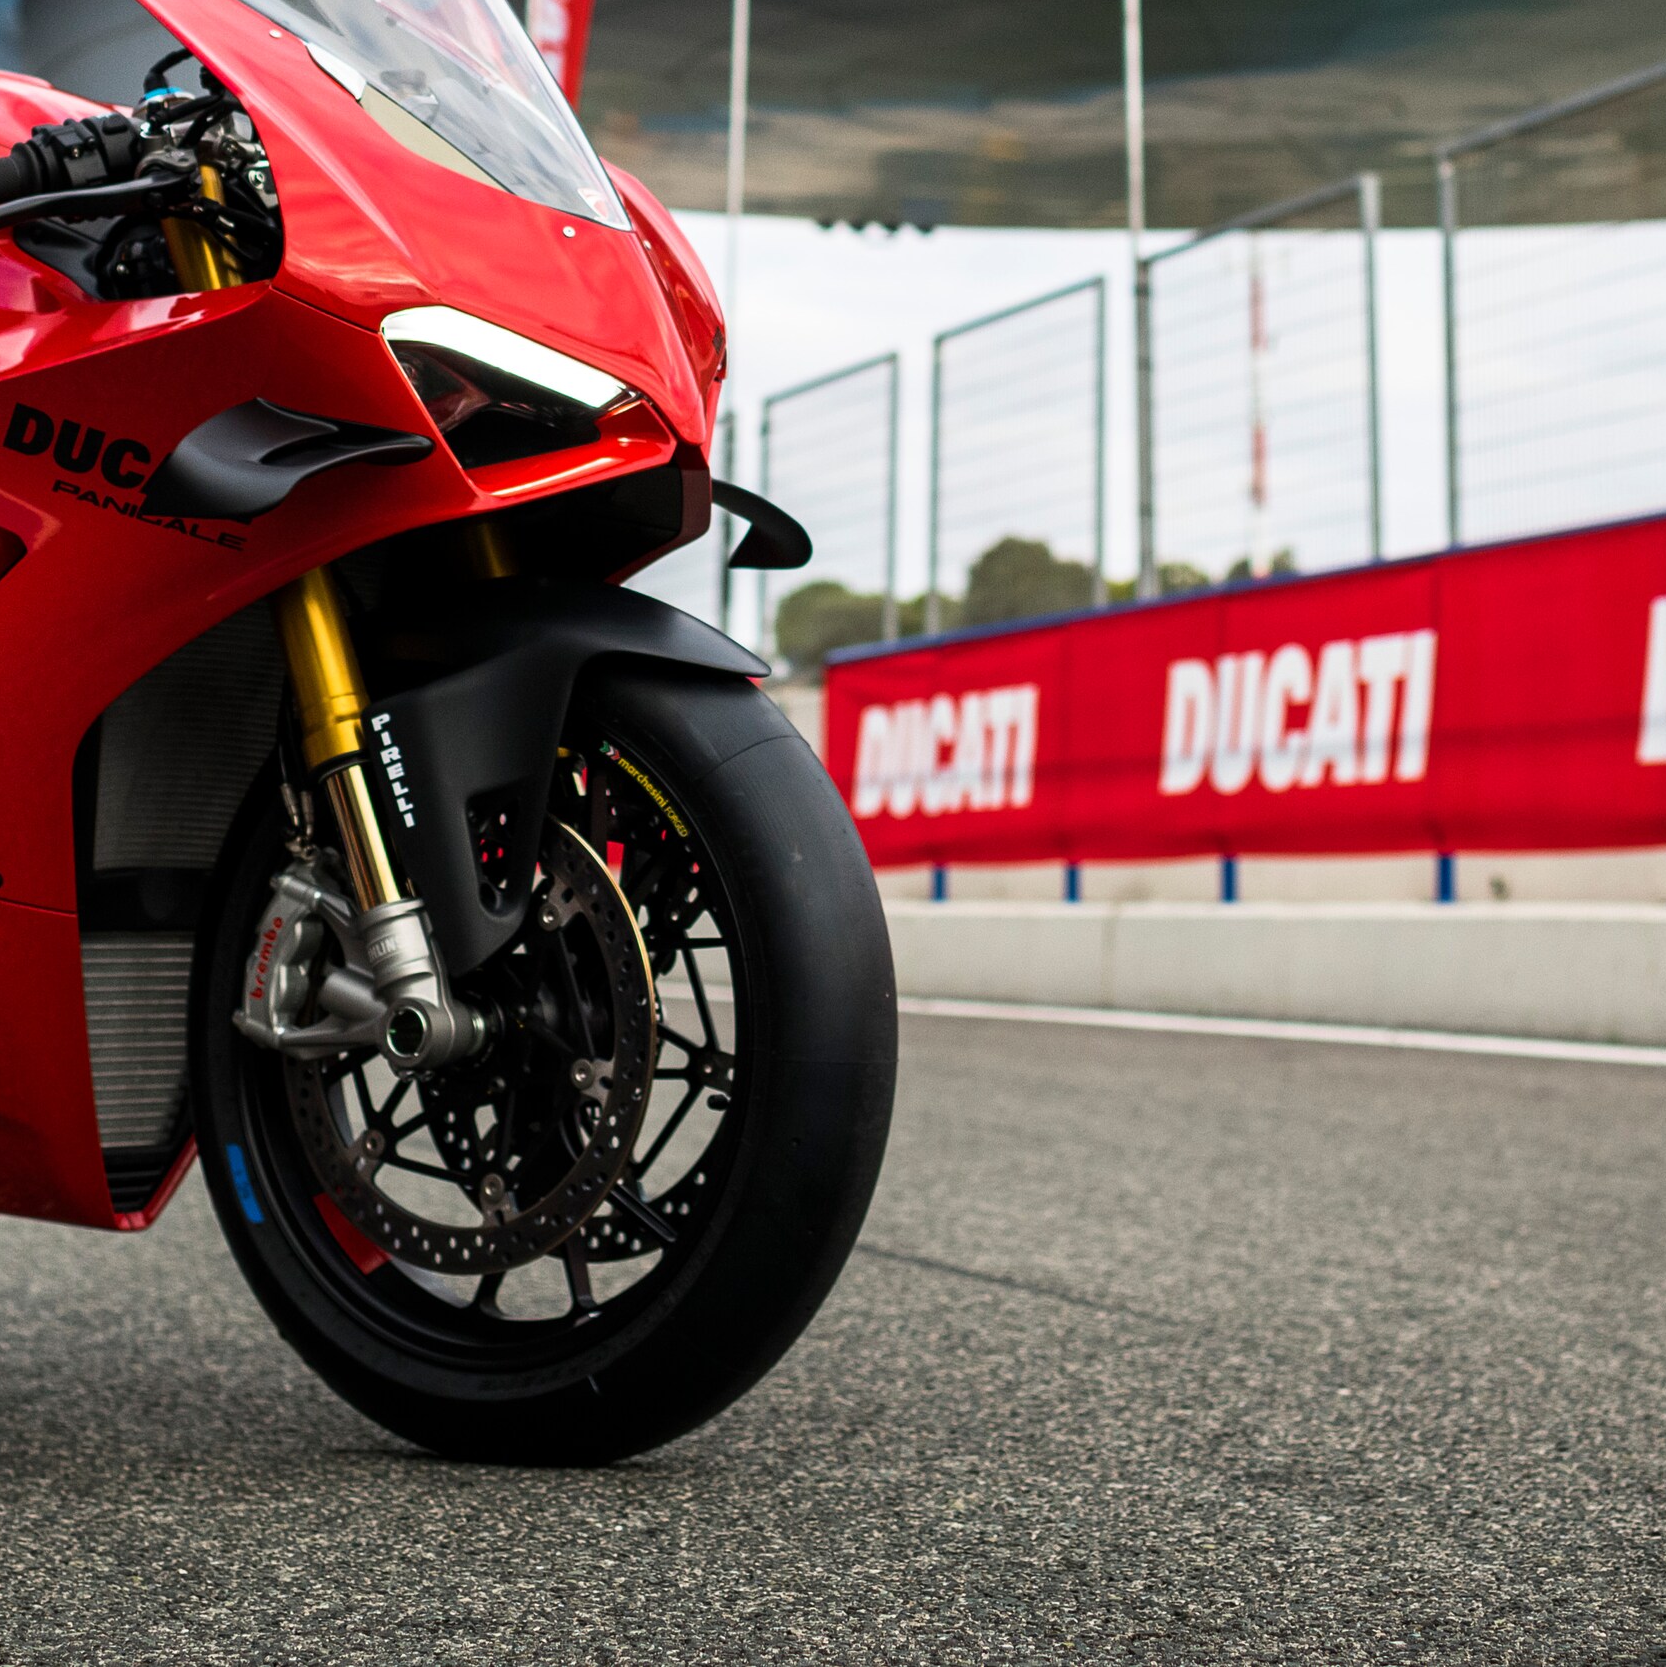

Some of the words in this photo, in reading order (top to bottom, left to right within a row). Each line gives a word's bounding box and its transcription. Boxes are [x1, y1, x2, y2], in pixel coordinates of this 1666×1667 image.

[853, 682, 1039, 818] DUCATI
[1158, 629, 1437, 795] DUCATI
[371, 713, 415, 828] PIRELLI
[617, 757, 669, 808] marchesini
[664, 805, 689, 837] FORGED
[250, 916, 284, 1000] brembo
